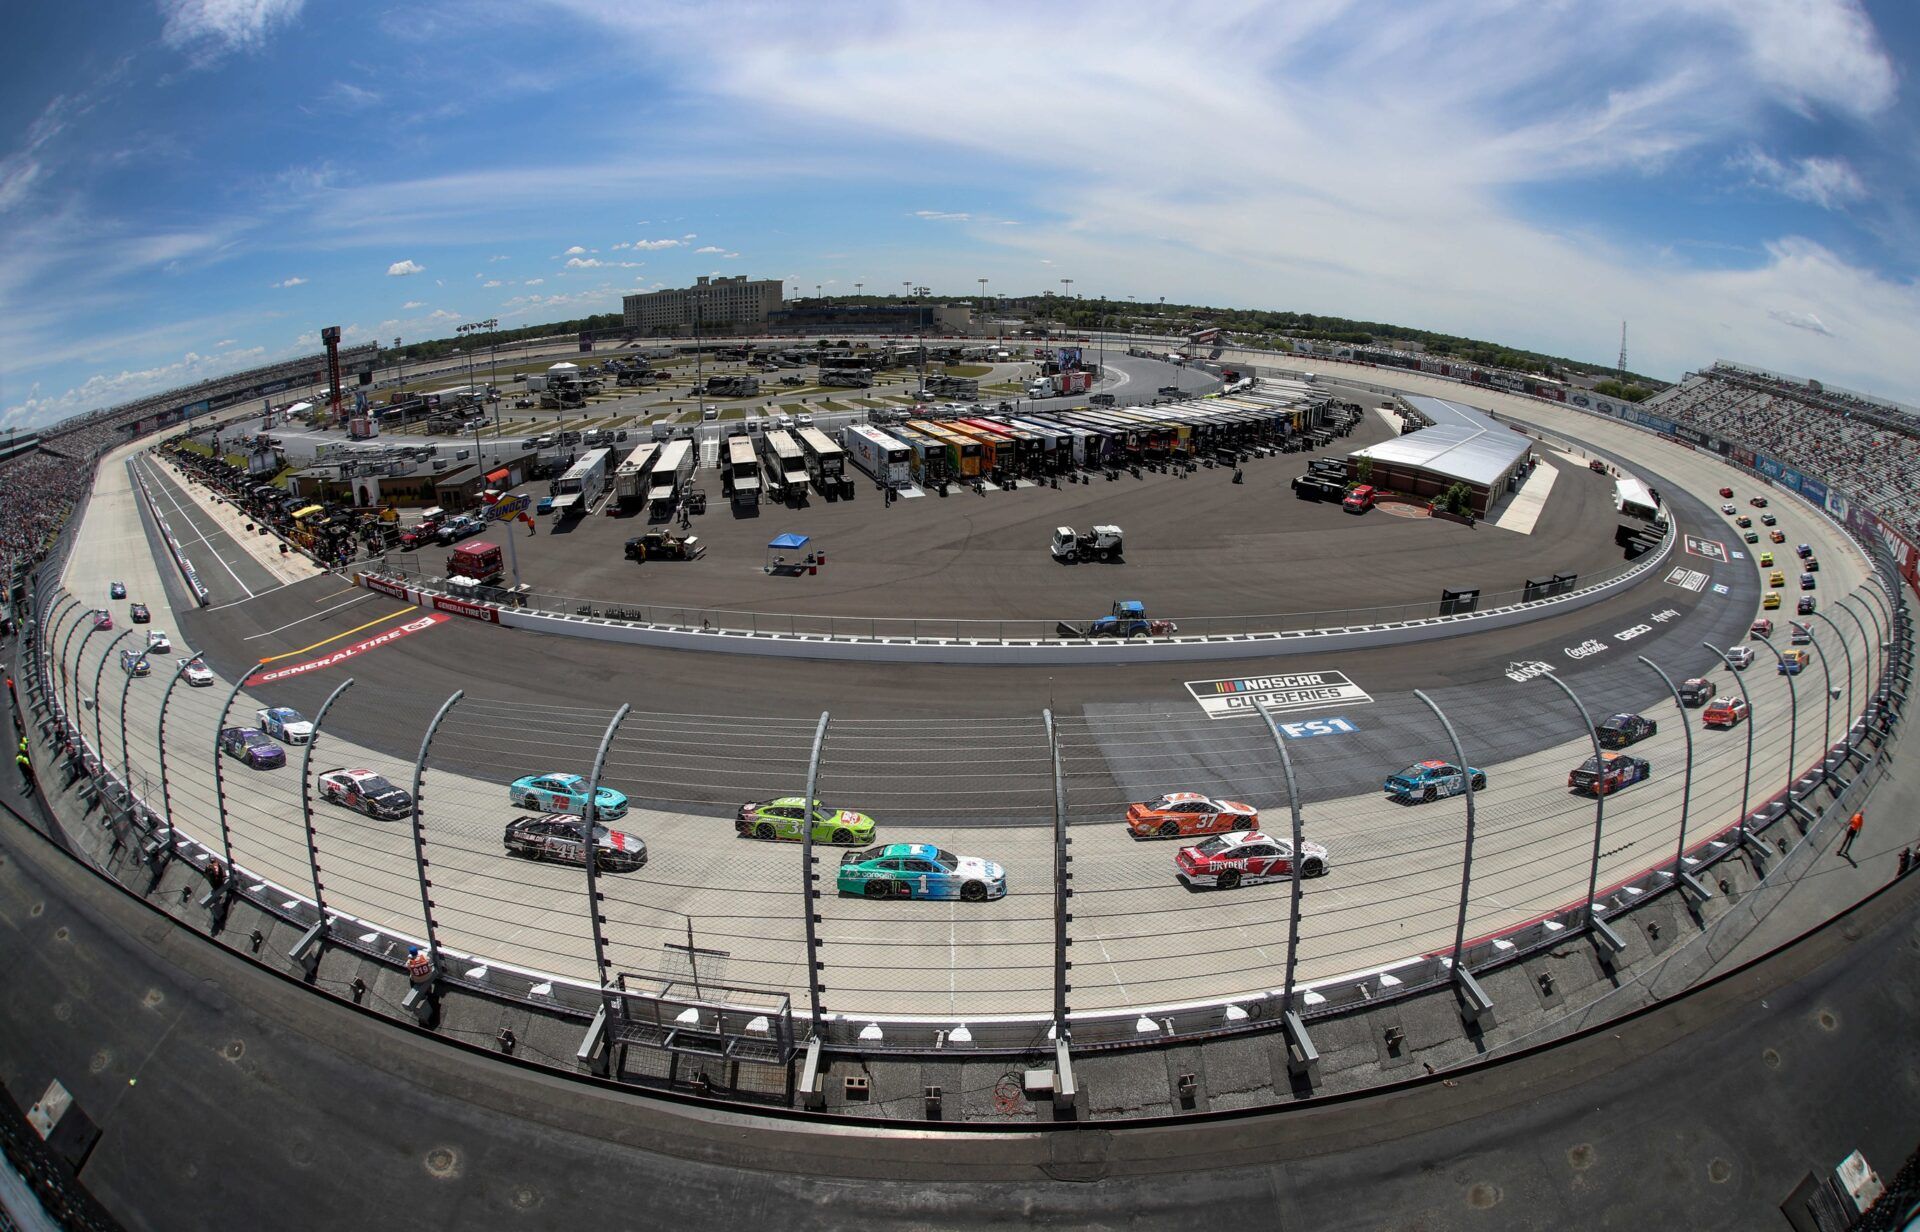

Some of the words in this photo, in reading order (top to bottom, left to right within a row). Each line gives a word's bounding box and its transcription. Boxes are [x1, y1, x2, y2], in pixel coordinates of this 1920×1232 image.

[1490, 375, 1525, 391] Smithfield
[488, 498, 529, 519] SUNOCO
[438, 601, 465, 613] GENERAL
[464, 607, 480, 617] TIRE
[1613, 624, 1652, 641] GEICO
[262, 649, 358, 680] GENERAL
[357, 630, 401, 650] TIRE
[1505, 661, 1557, 683] BUSCH
[1244, 674, 1325, 691] NASCAR
[1226, 694, 1269, 708] CUP
[1275, 688, 1342, 704] SERIES
[1281, 719, 1354, 737] FS1
[1447, 777, 1461, 790] 43
[1196, 814, 1218, 829] 37
[557, 843, 576, 860] 41
[1209, 857, 1249, 872] DRYDENE
[1260, 858, 1280, 877] 7
[917, 875, 929, 894] 1
